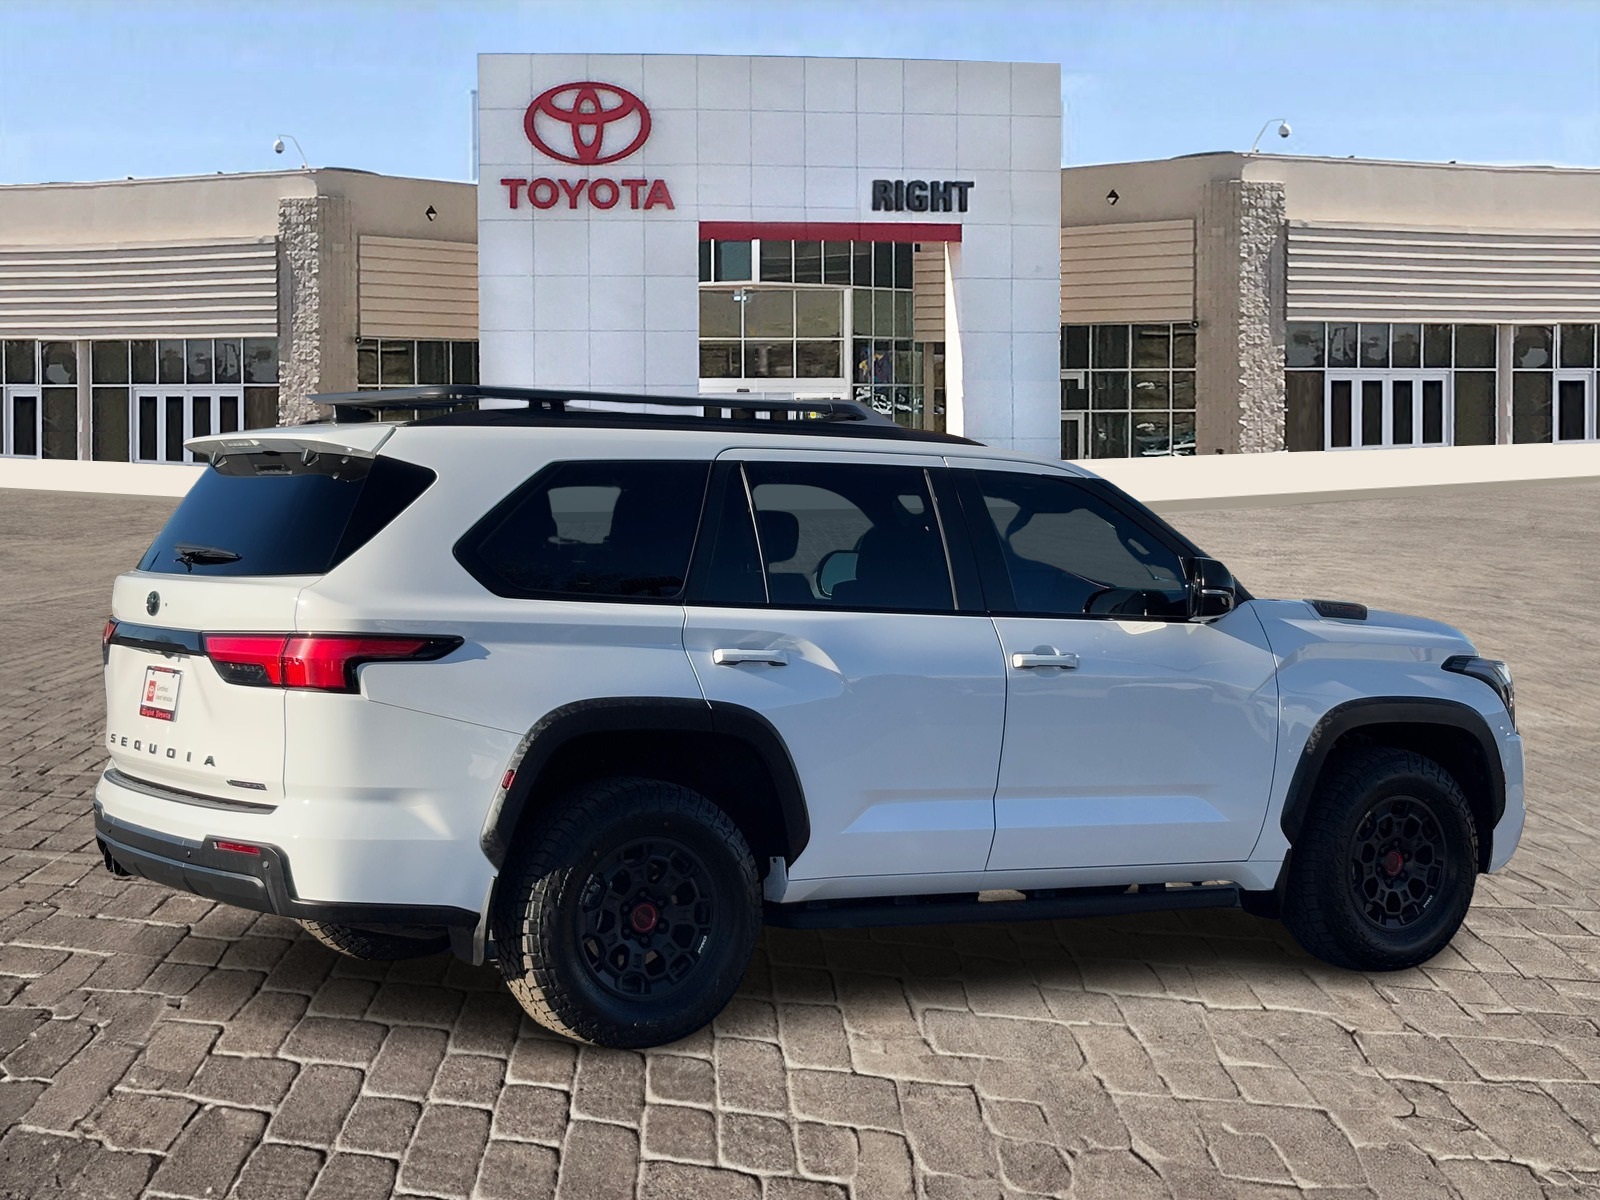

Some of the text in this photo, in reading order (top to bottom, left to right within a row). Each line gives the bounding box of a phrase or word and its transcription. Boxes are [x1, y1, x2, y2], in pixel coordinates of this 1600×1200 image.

[501, 178, 675, 211] TOYOTA
[872, 179, 975, 213] RIGHT
[110, 733, 216, 768] SEQUOIA
